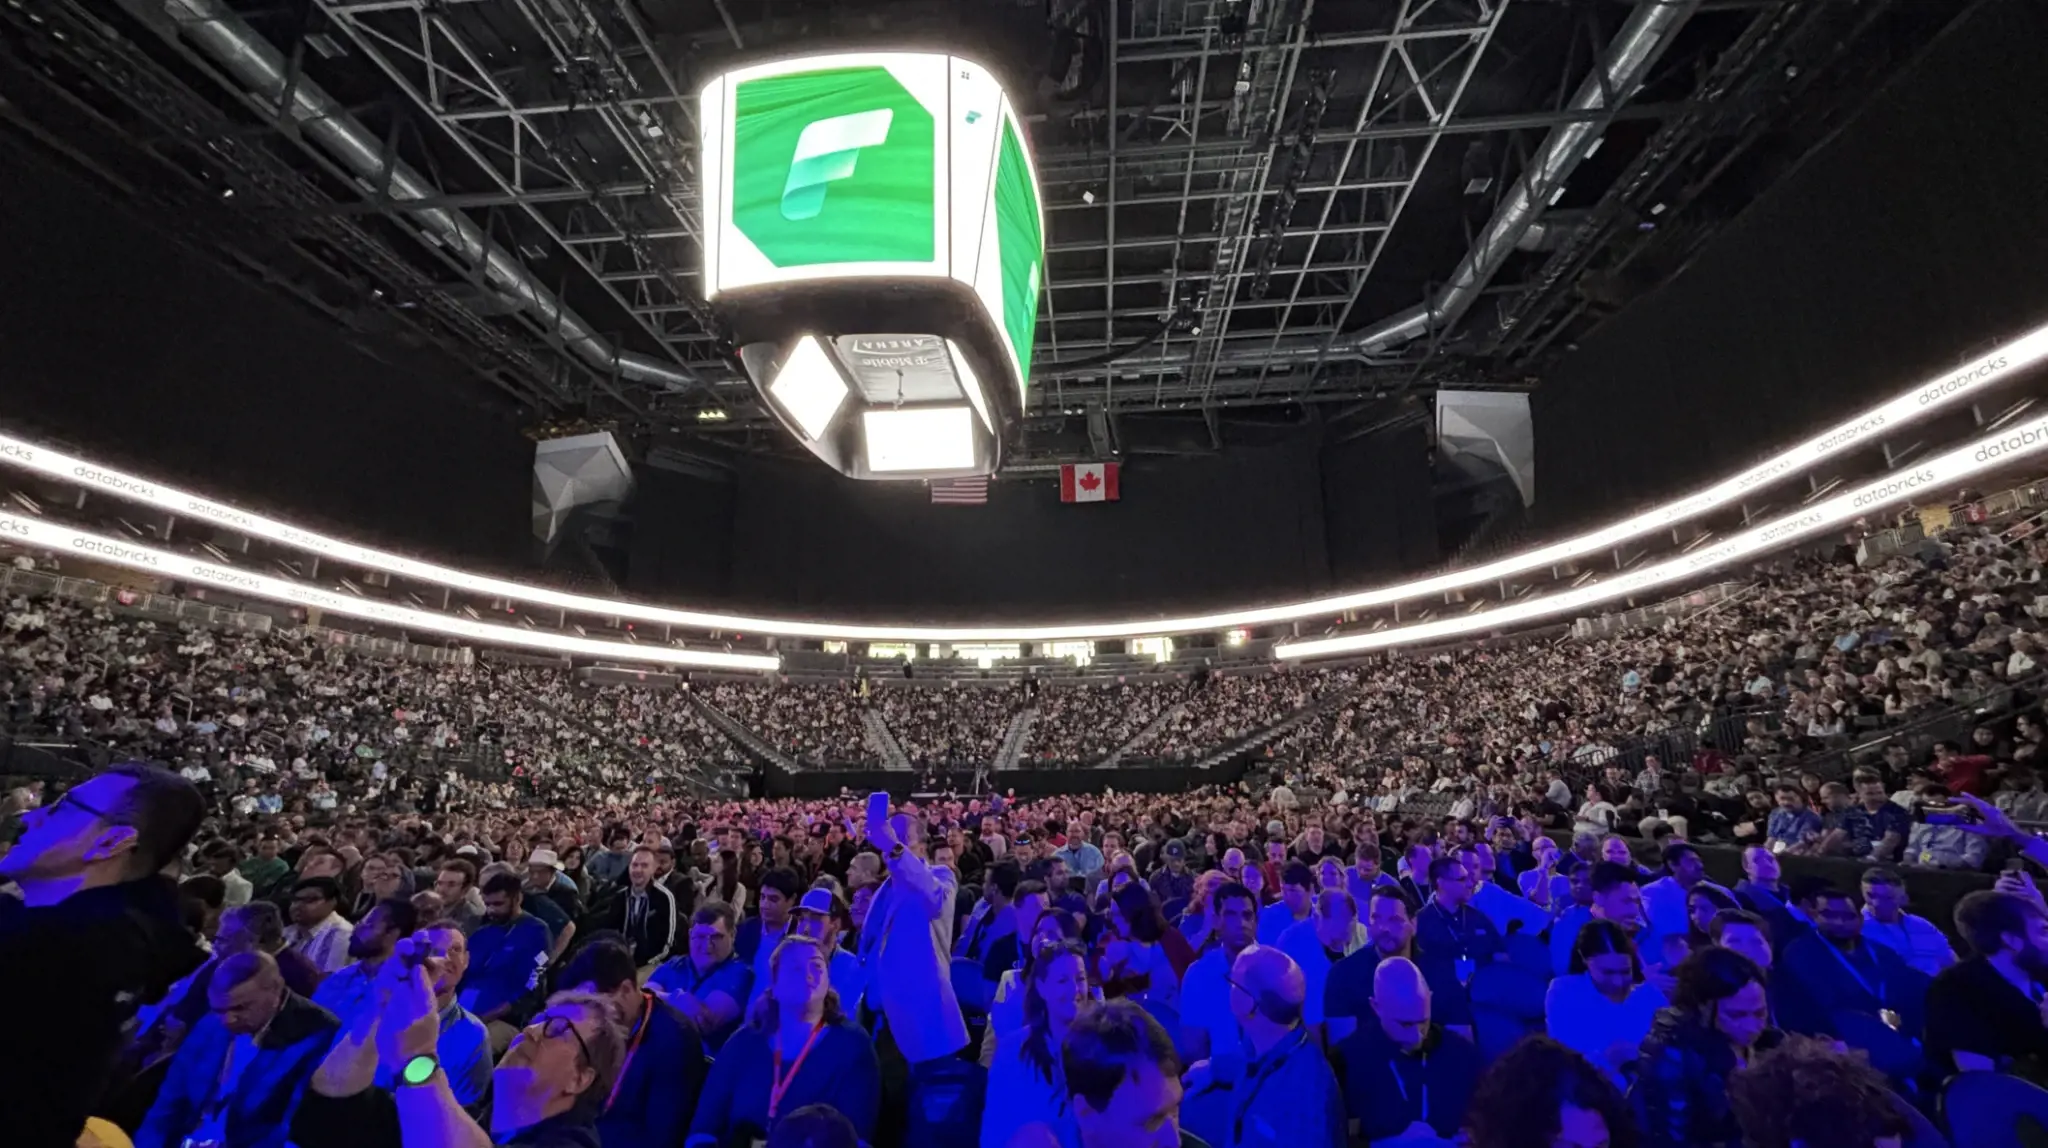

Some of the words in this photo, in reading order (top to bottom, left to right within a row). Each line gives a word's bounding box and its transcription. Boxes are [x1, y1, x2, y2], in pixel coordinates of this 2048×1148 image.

[862, 338, 923, 350] ARENA
[862, 356, 914, 368] Mobile
[1918, 356, 2008, 406] databricks
[1816, 414, 1886, 453] databricks
[73, 466, 155, 498] databricks
[1853, 468, 1935, 508] databricks
[188, 501, 253, 528] databricks
[1760, 512, 1823, 542] databricks
[72, 537, 158, 565] databricks
[192, 565, 261, 589] databricks
